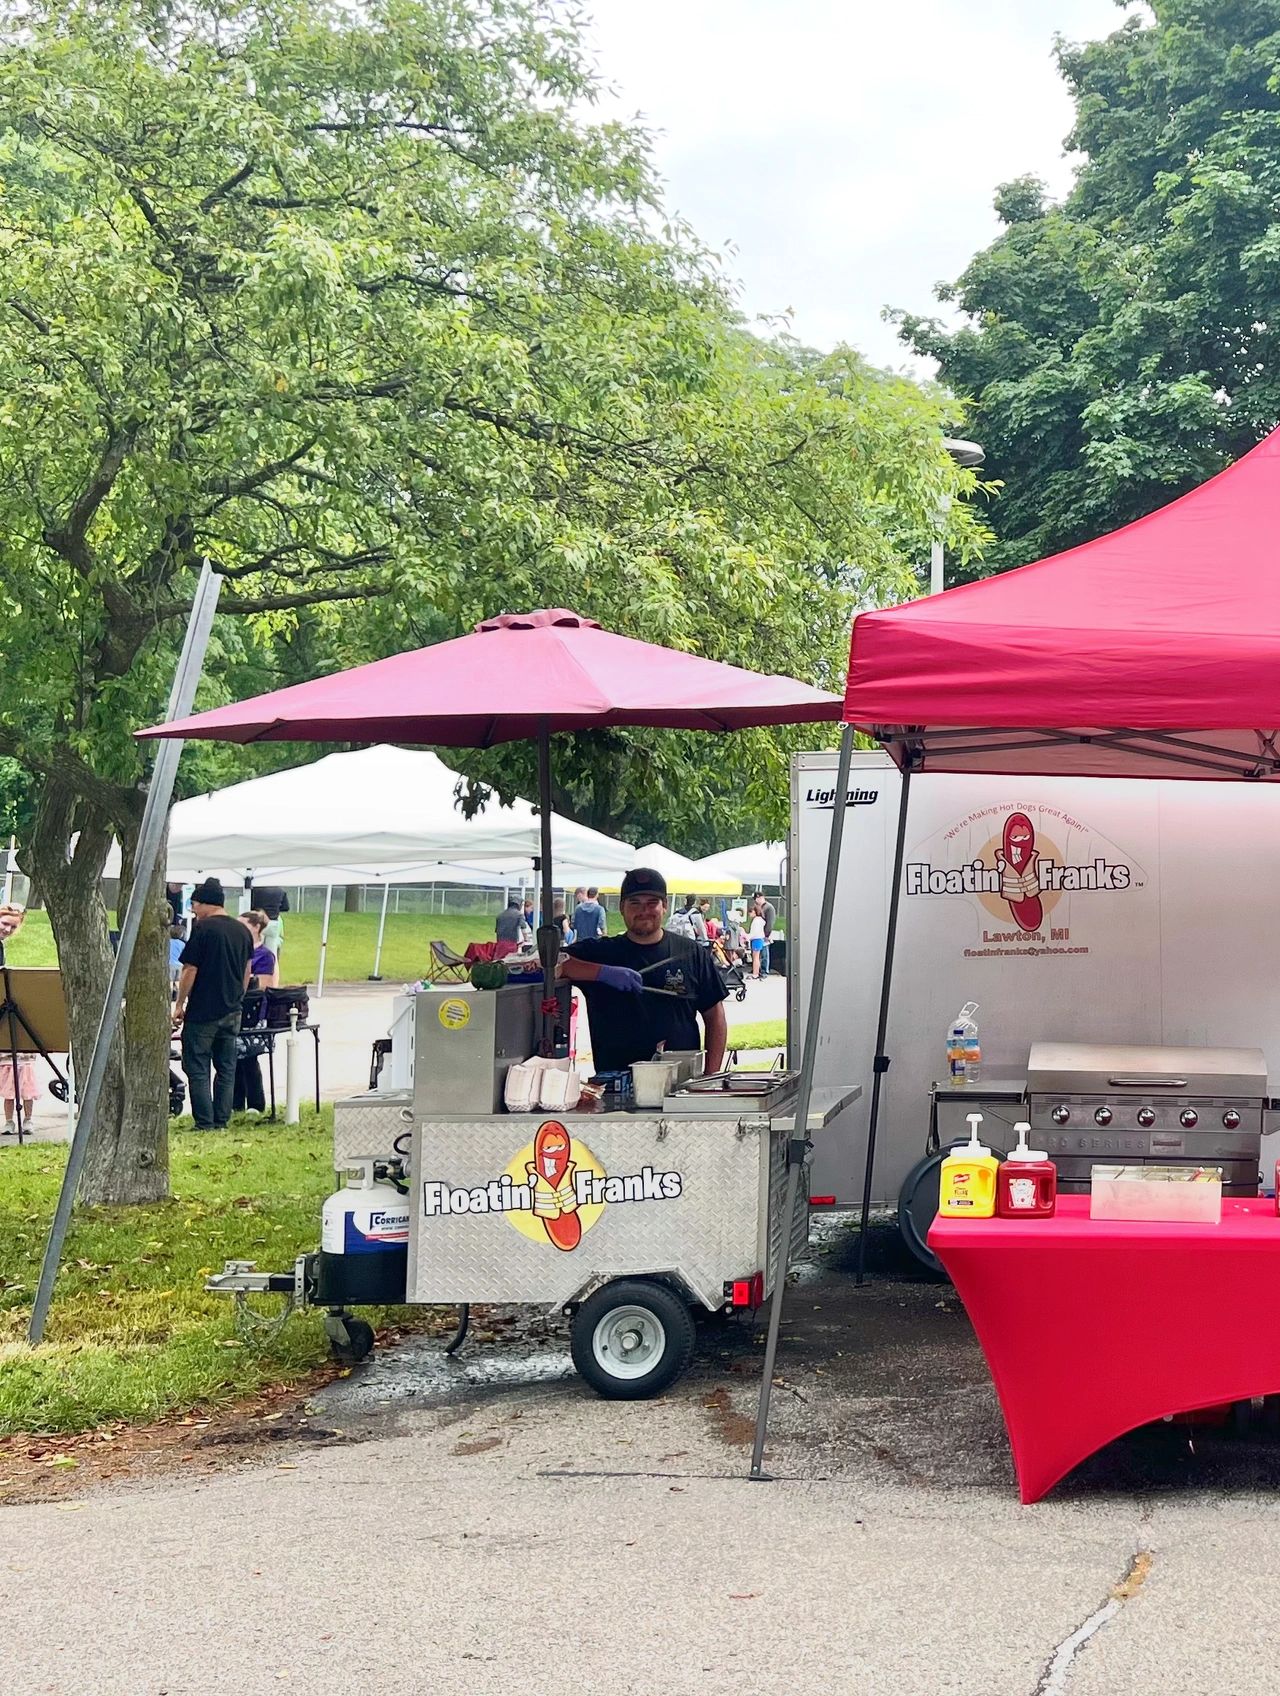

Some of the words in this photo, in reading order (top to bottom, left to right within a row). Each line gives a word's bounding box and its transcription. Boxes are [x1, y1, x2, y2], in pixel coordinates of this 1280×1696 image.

[806, 788, 879, 805] Lighning
[968, 805, 999, 823] Making
[999, 803, 1015, 812] Hot
[1016, 802, 1037, 813] Dogs
[1038, 804, 1062, 819] Great
[906, 859, 1006, 895] Floatin'
[1037, 858, 1131, 891] Franks
[982, 929, 1047, 943] Lawton,
[1050, 927, 1070, 941] MI
[1078, 1135, 1147, 1149] SERIES
[423, 1173, 538, 1217] Floatin'
[574, 1166, 682, 1206] Franks
